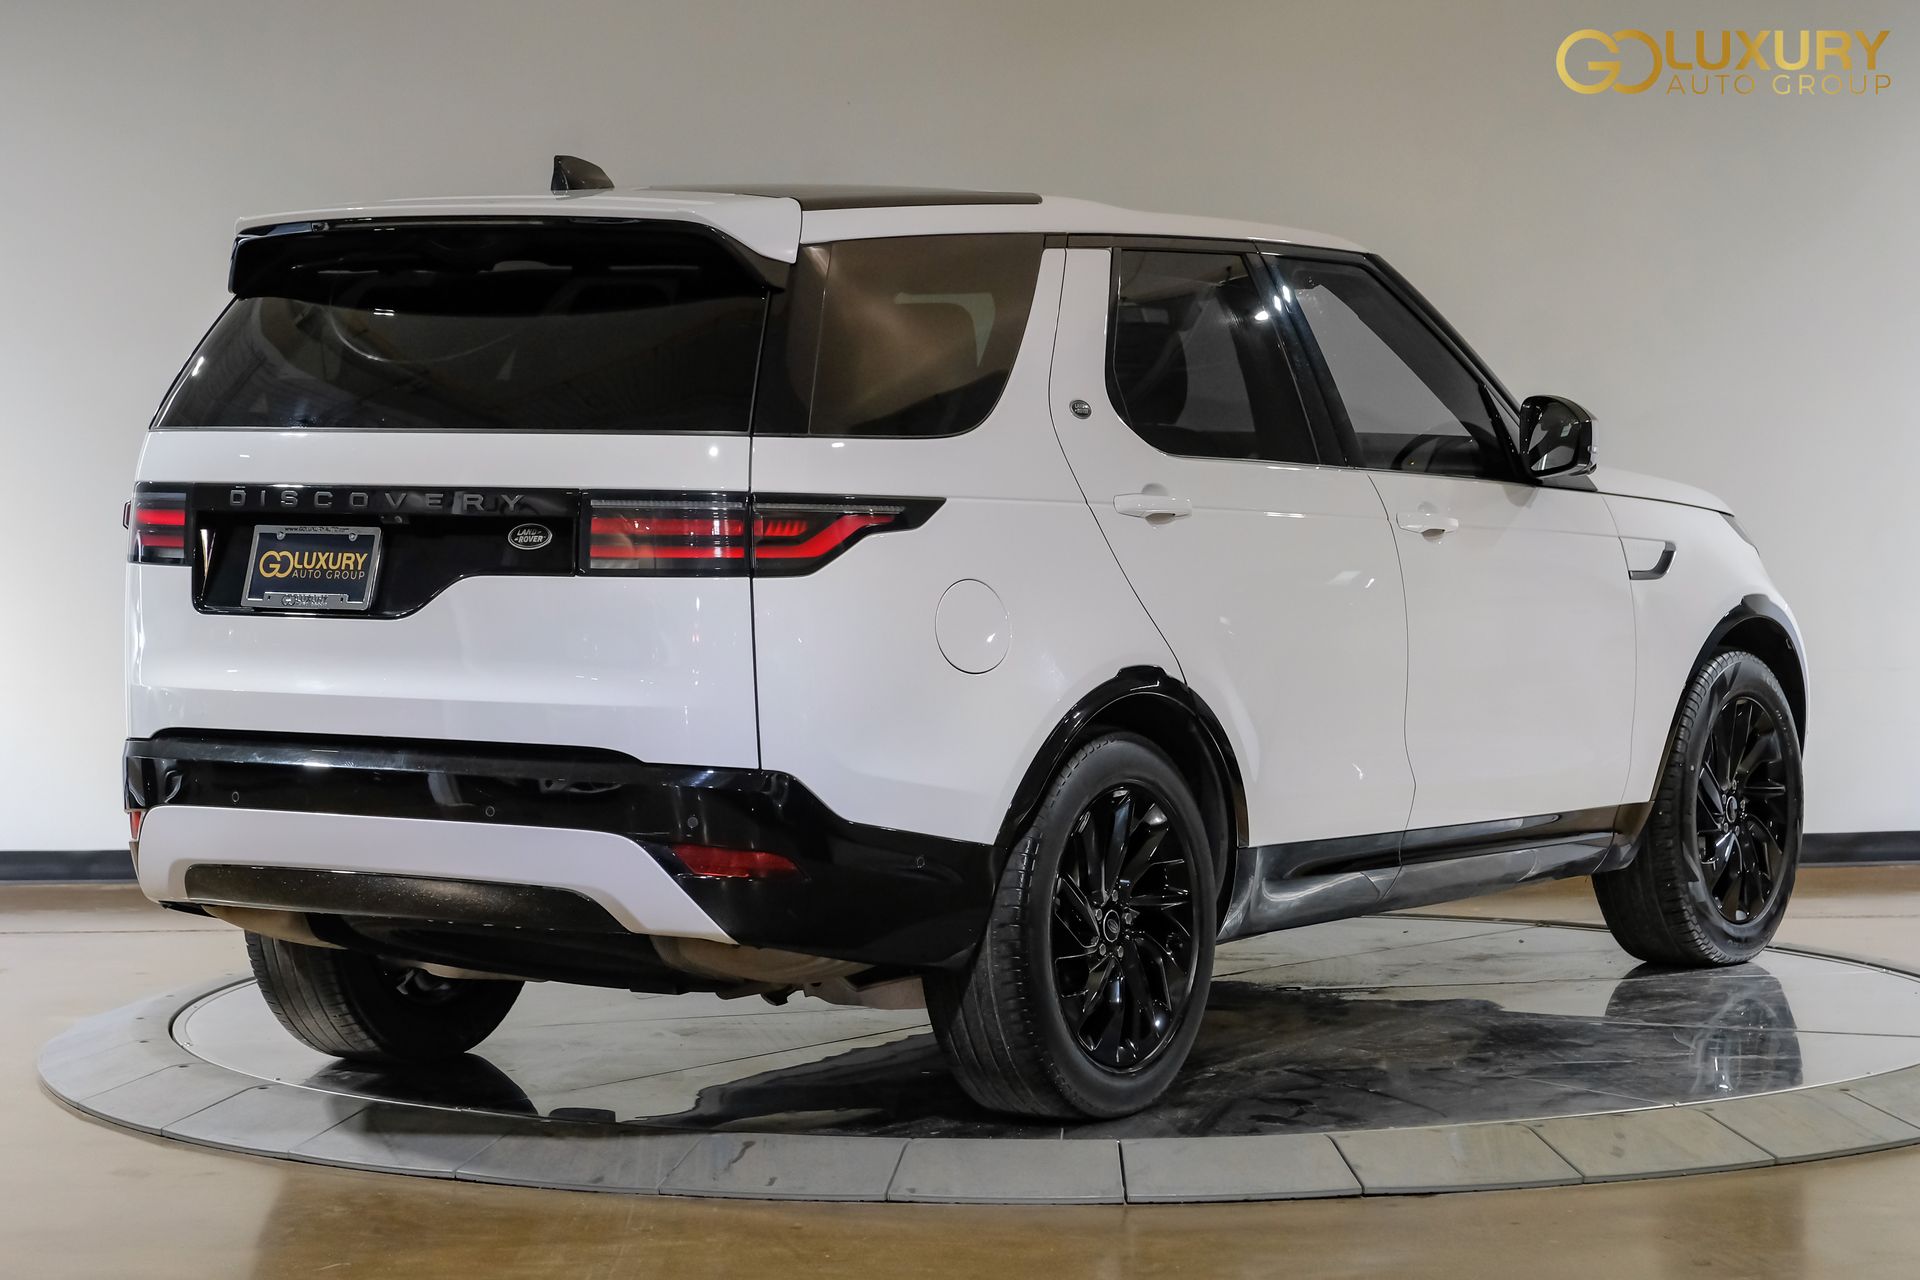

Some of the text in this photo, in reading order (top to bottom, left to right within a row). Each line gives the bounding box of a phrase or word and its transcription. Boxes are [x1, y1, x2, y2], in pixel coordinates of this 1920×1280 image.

[229, 488, 524, 512] DISCOVERY
[518, 535, 544, 543] ROVER
[293, 551, 368, 571] LUXURY
[292, 569, 365, 580] AUTO GROUP
